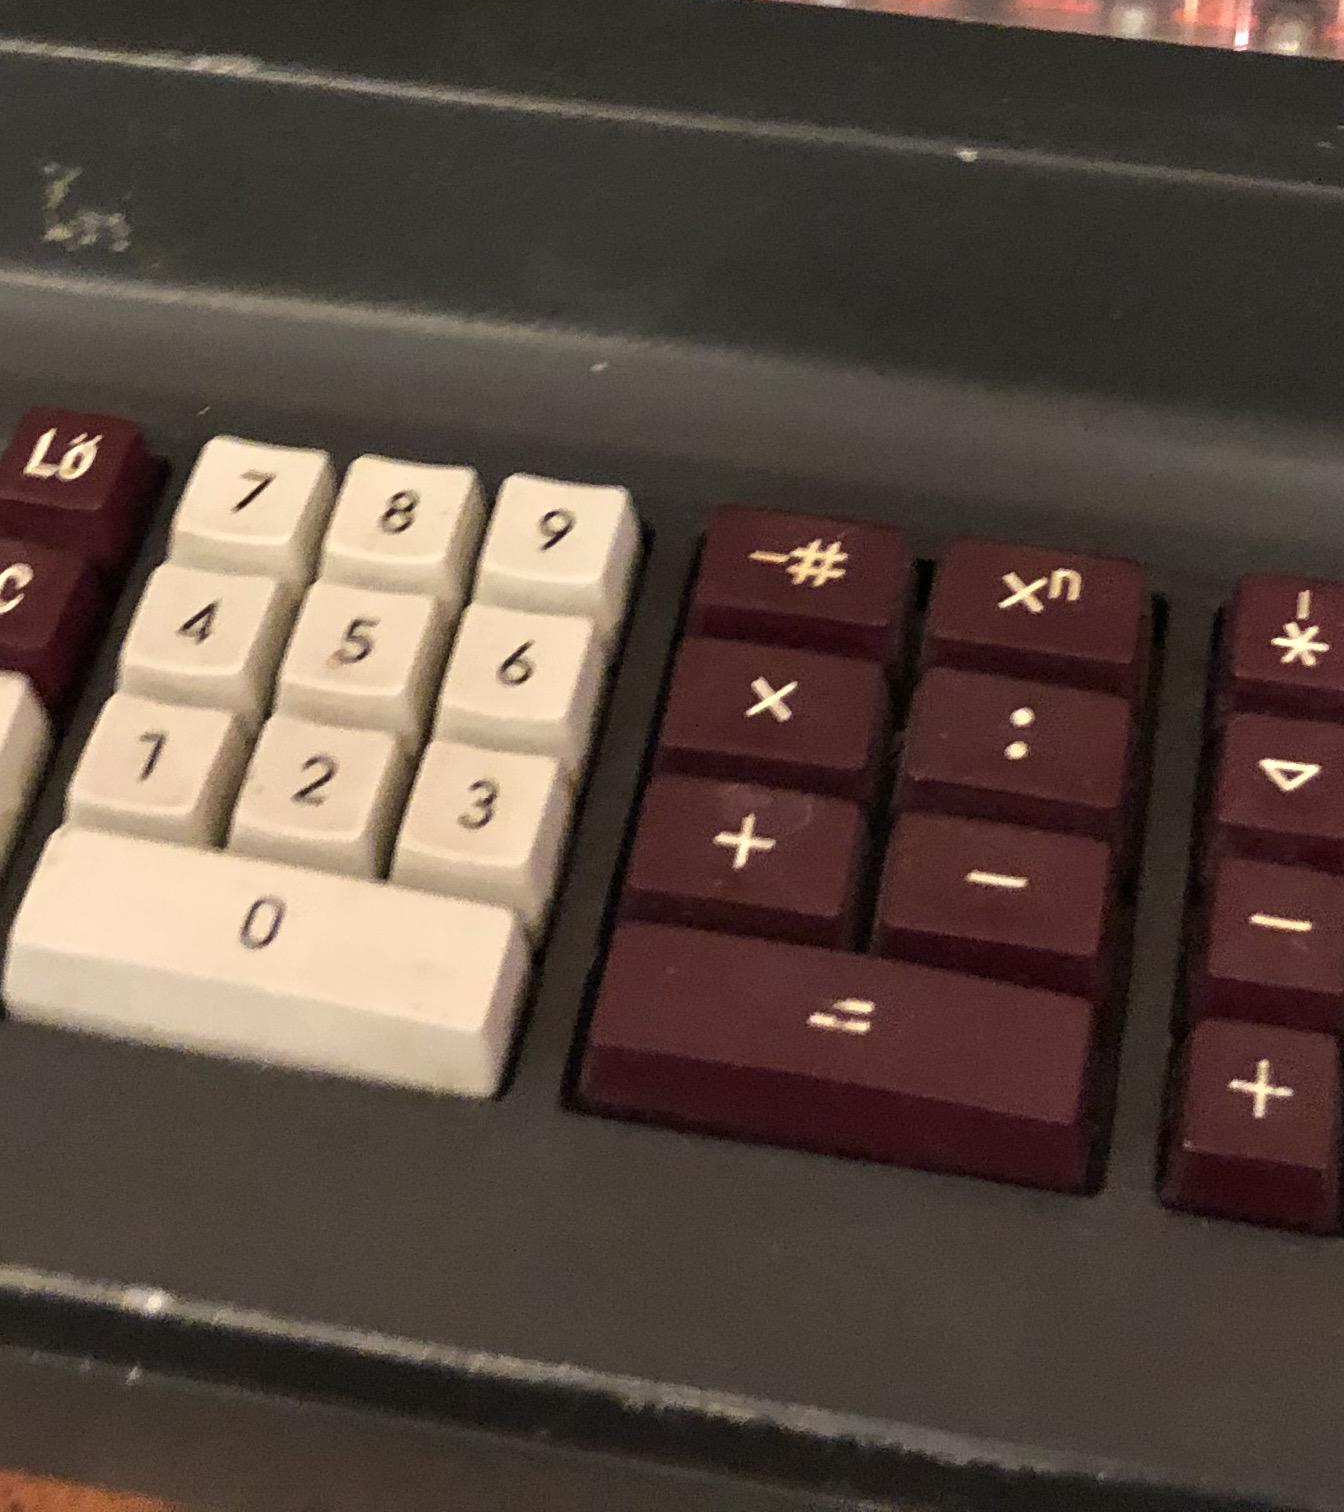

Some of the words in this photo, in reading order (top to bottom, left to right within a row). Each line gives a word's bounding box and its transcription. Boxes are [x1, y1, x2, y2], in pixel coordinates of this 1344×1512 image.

[230, 471, 277, 514] 7
[378, 490, 420, 536] 8
[538, 508, 576, 553] 9
[176, 599, 220, 646] 4
[331, 617, 380, 666] 5
[495, 639, 535, 687] 6
[137, 730, 168, 782] 1
[289, 753, 339, 807] 2
[456, 778, 499, 832] 3
[238, 896, 287, 952] 0
